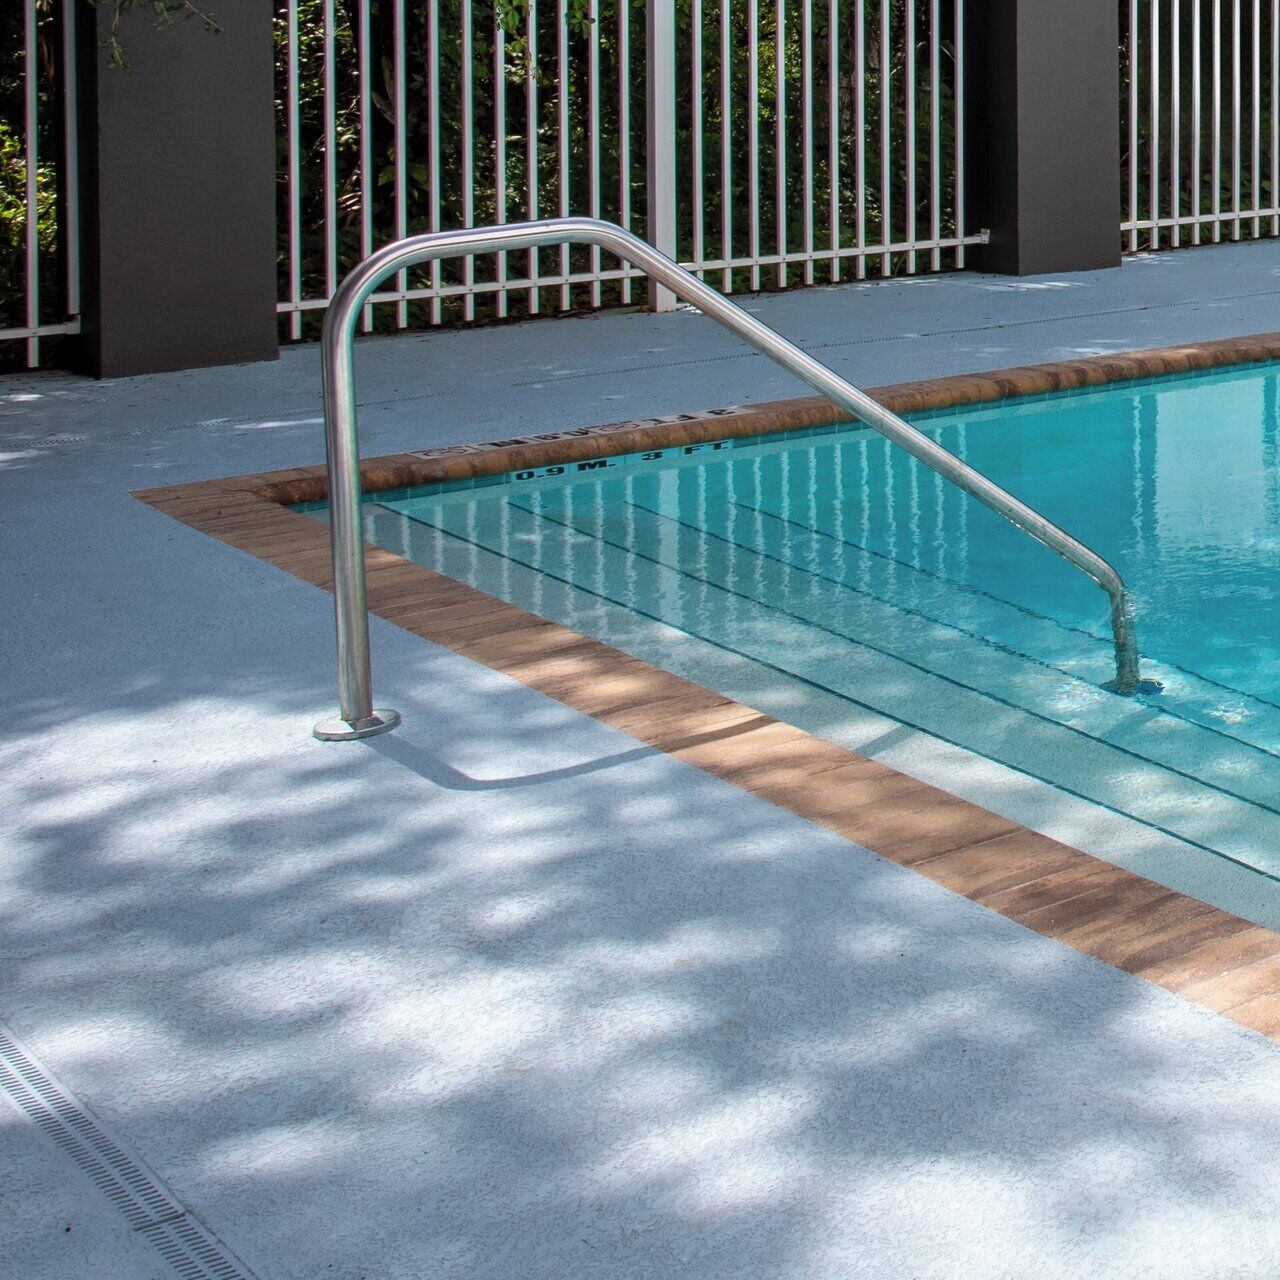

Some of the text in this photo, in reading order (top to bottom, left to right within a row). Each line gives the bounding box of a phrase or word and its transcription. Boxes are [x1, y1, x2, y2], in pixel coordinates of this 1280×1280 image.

[641, 451, 663, 461] 3
[516, 460, 616, 480] 0.9 M.
